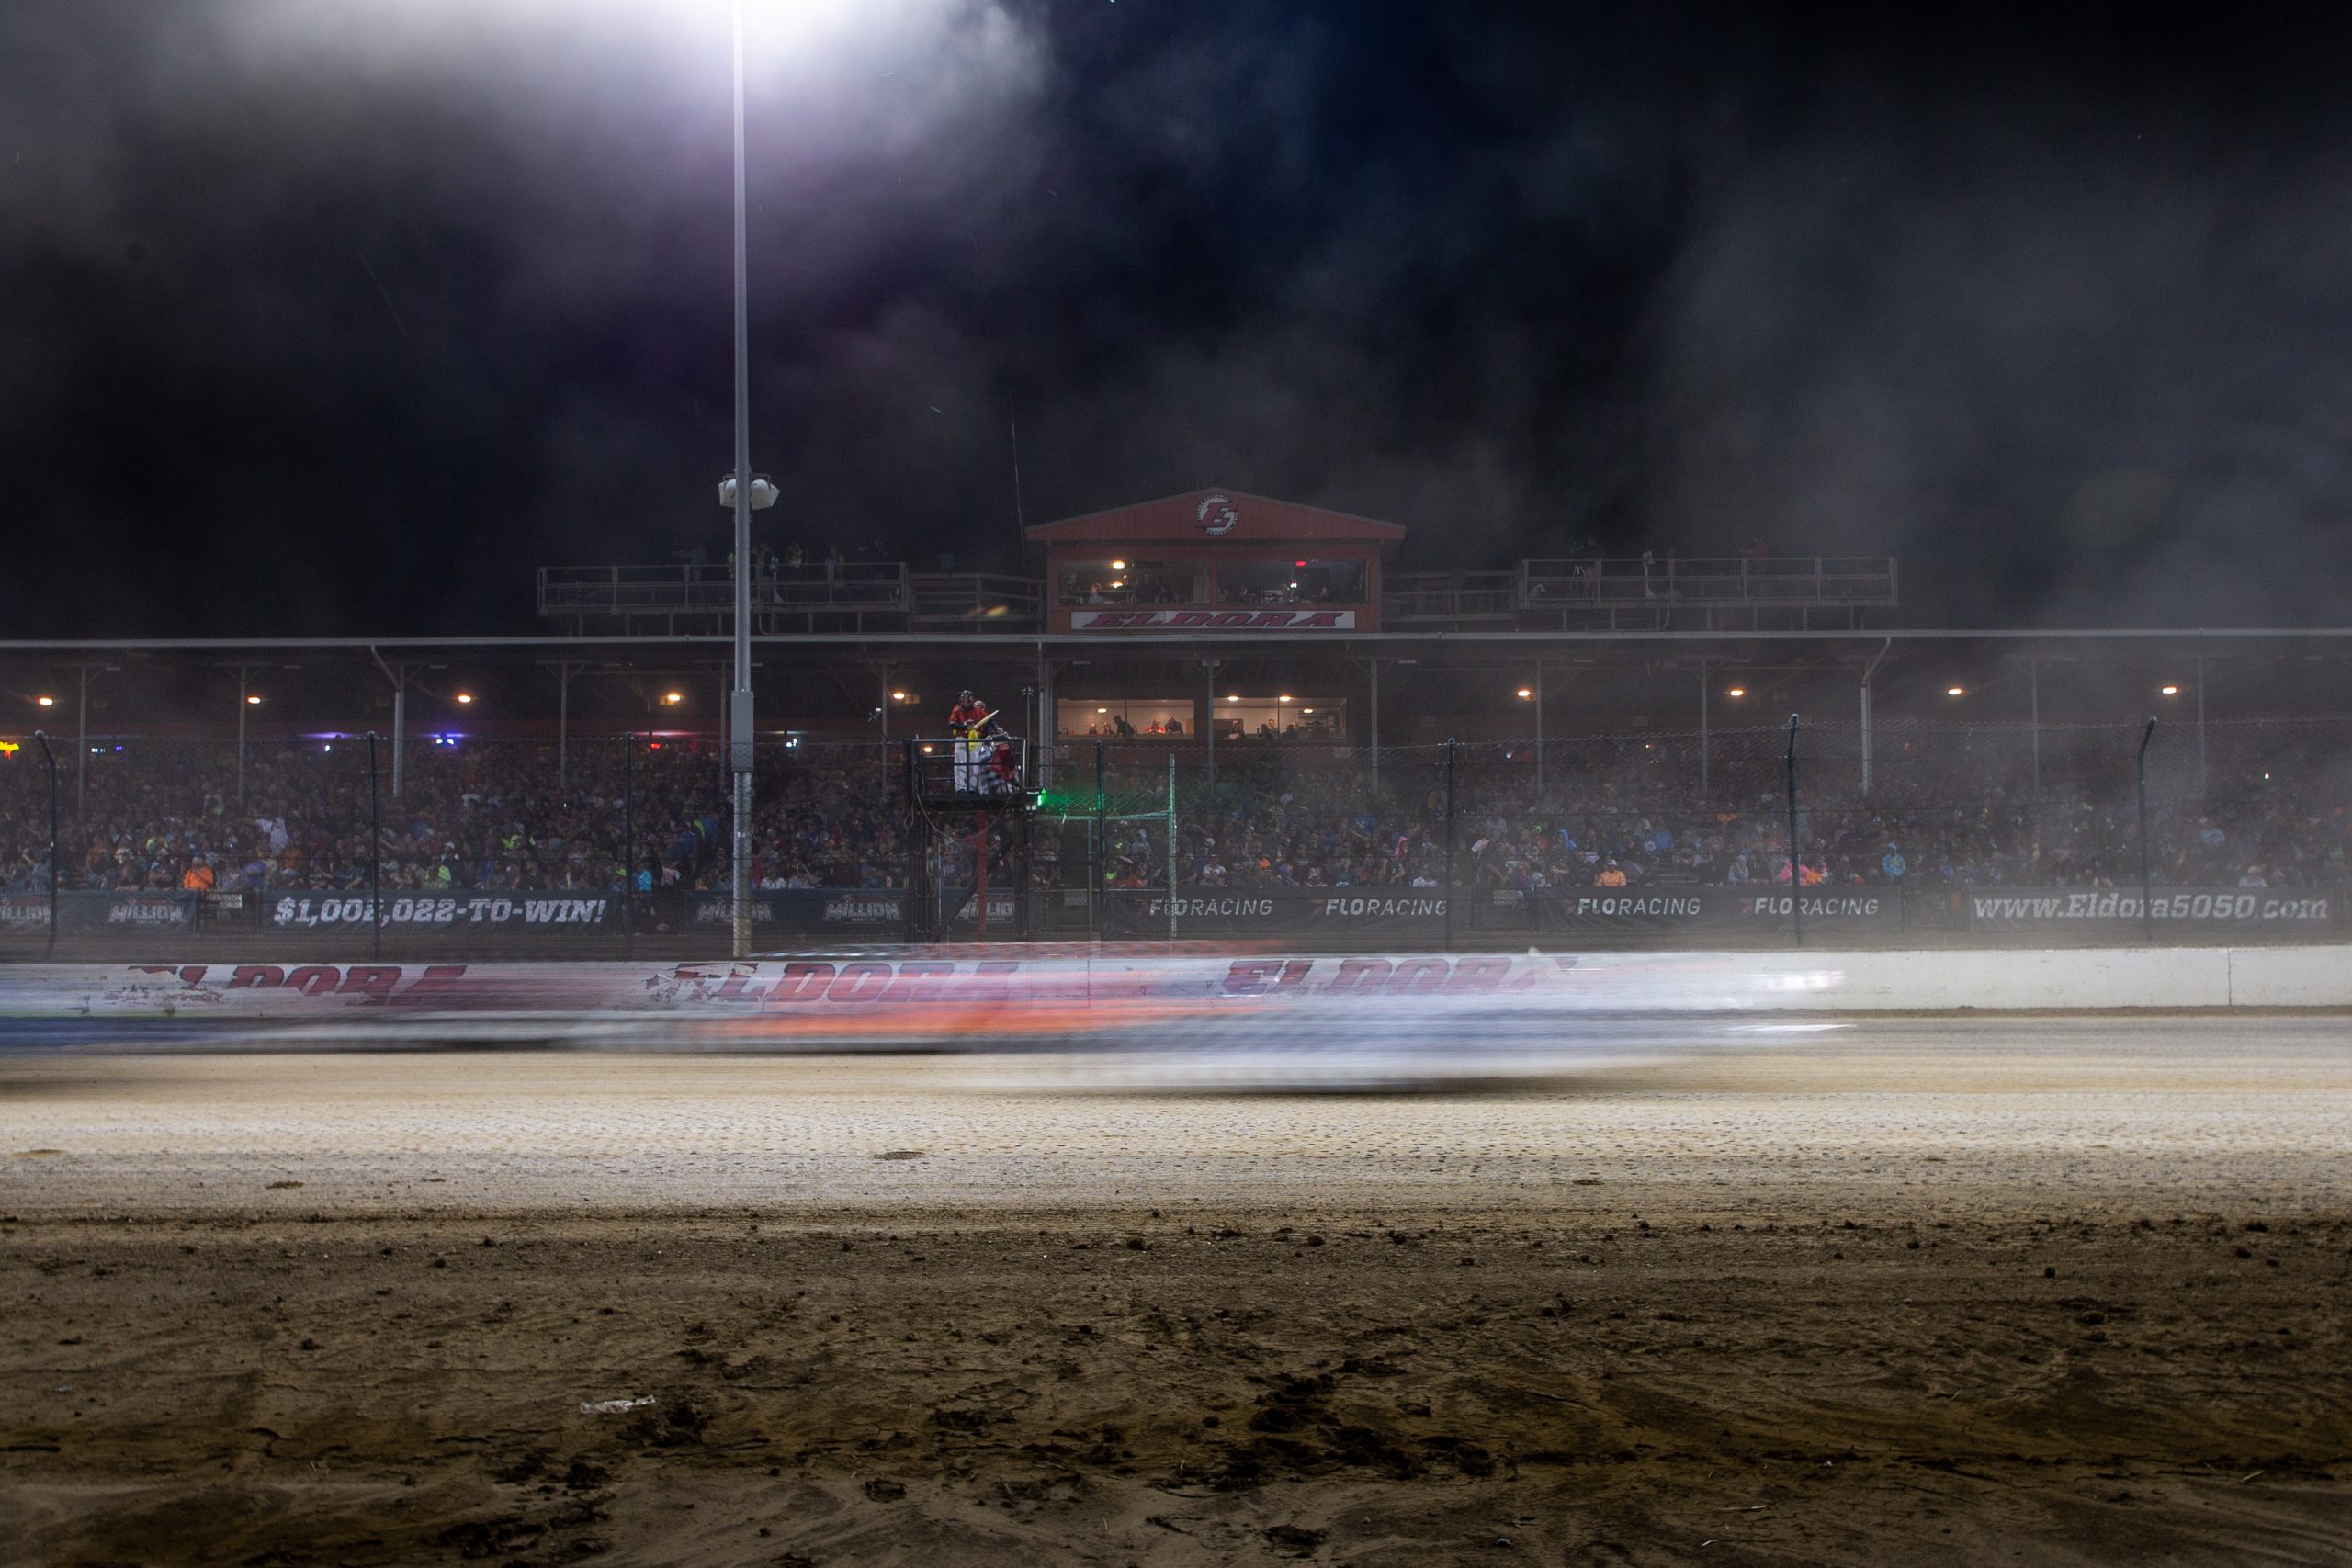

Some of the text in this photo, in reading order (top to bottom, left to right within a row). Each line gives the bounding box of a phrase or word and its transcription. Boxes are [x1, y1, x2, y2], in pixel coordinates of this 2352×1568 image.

[1083, 612, 1344, 628] ELDORA
[0, 905, 52, 924] ILLION
[274, 897, 606, 927] $1,002,022-TO-WIN!
[697, 903, 774, 921] MILN
[824, 902, 902, 920] MILLION
[1149, 899, 1272, 916] FLORACING
[1326, 898, 1448, 916] FLORACING
[1577, 898, 1701, 916] FLORACING
[1754, 897, 1879, 916] FLORACING
[1974, 893, 2328, 919] www.Eldora5050.com
